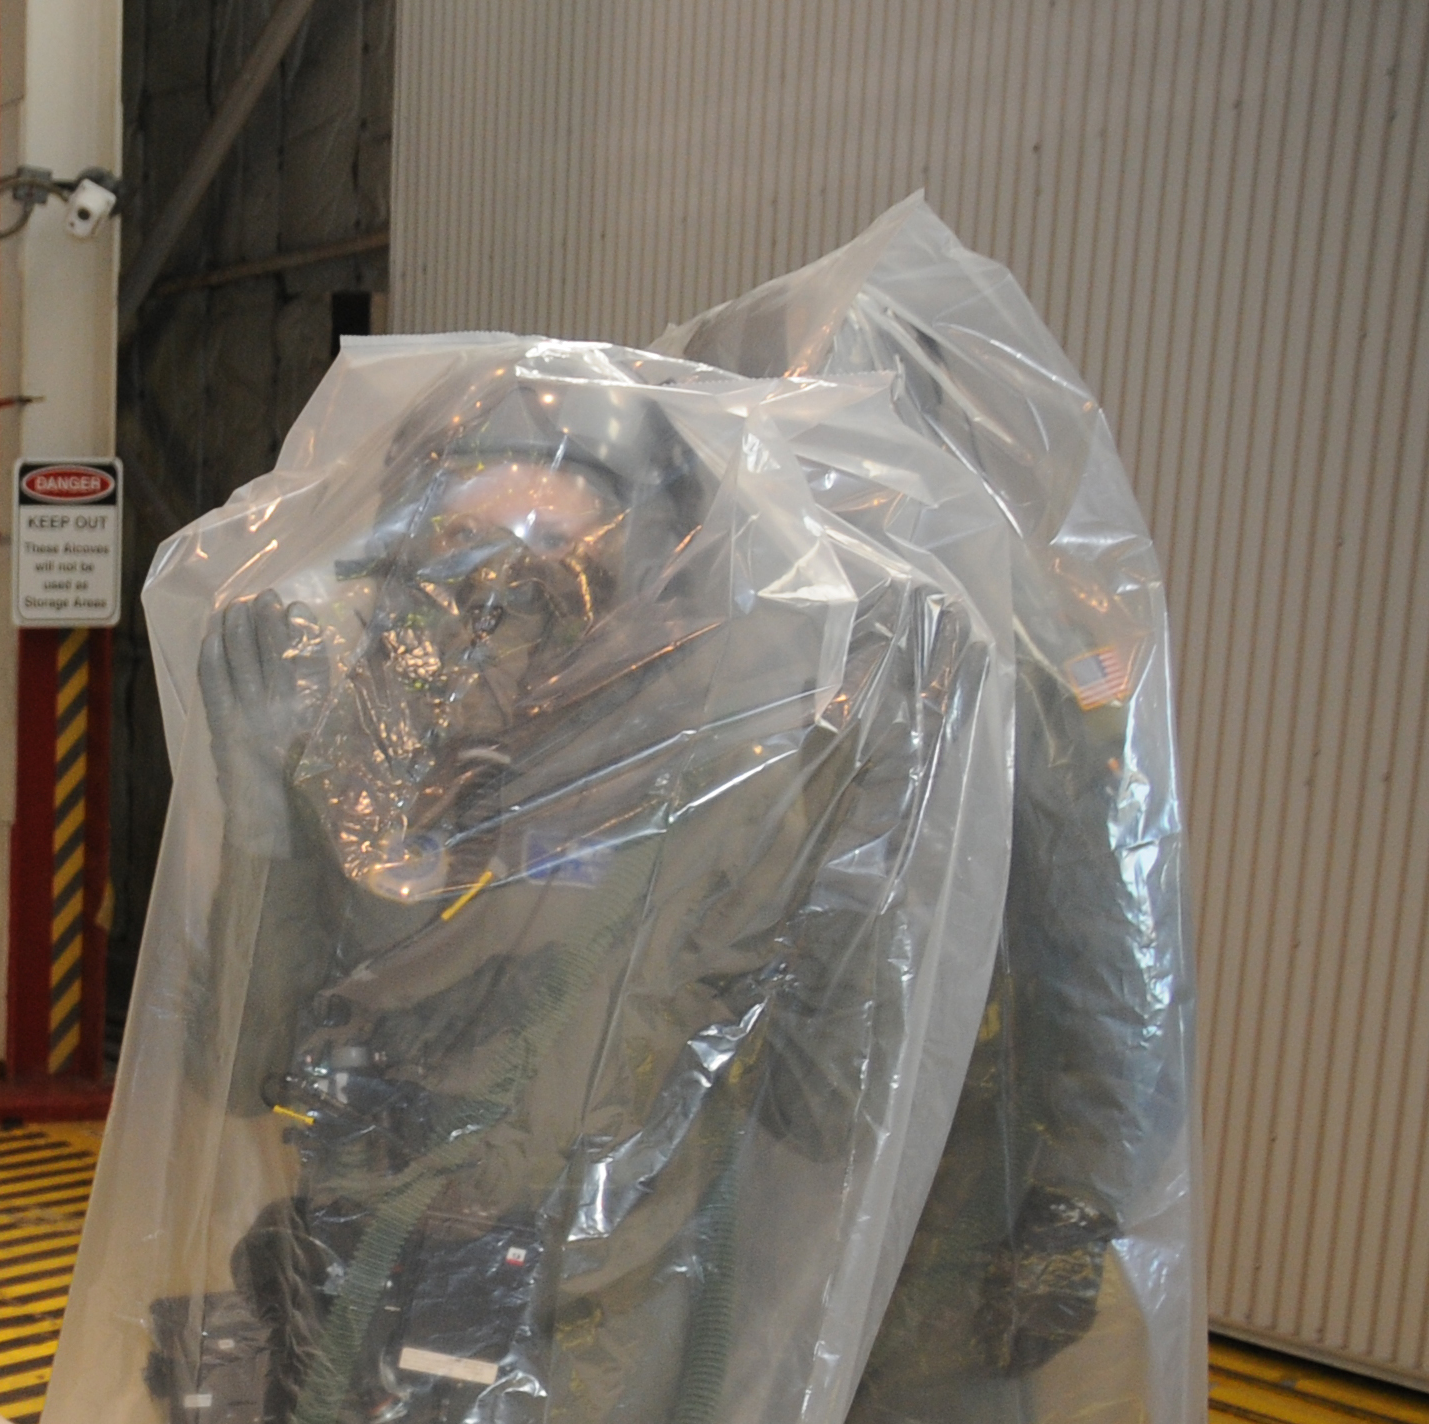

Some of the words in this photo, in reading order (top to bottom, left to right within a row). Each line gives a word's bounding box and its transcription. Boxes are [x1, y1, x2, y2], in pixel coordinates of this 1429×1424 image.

[34, 475, 102, 491] DANGER
[27, 514, 71, 529] KEEP
[74, 514, 109, 529] OUT
